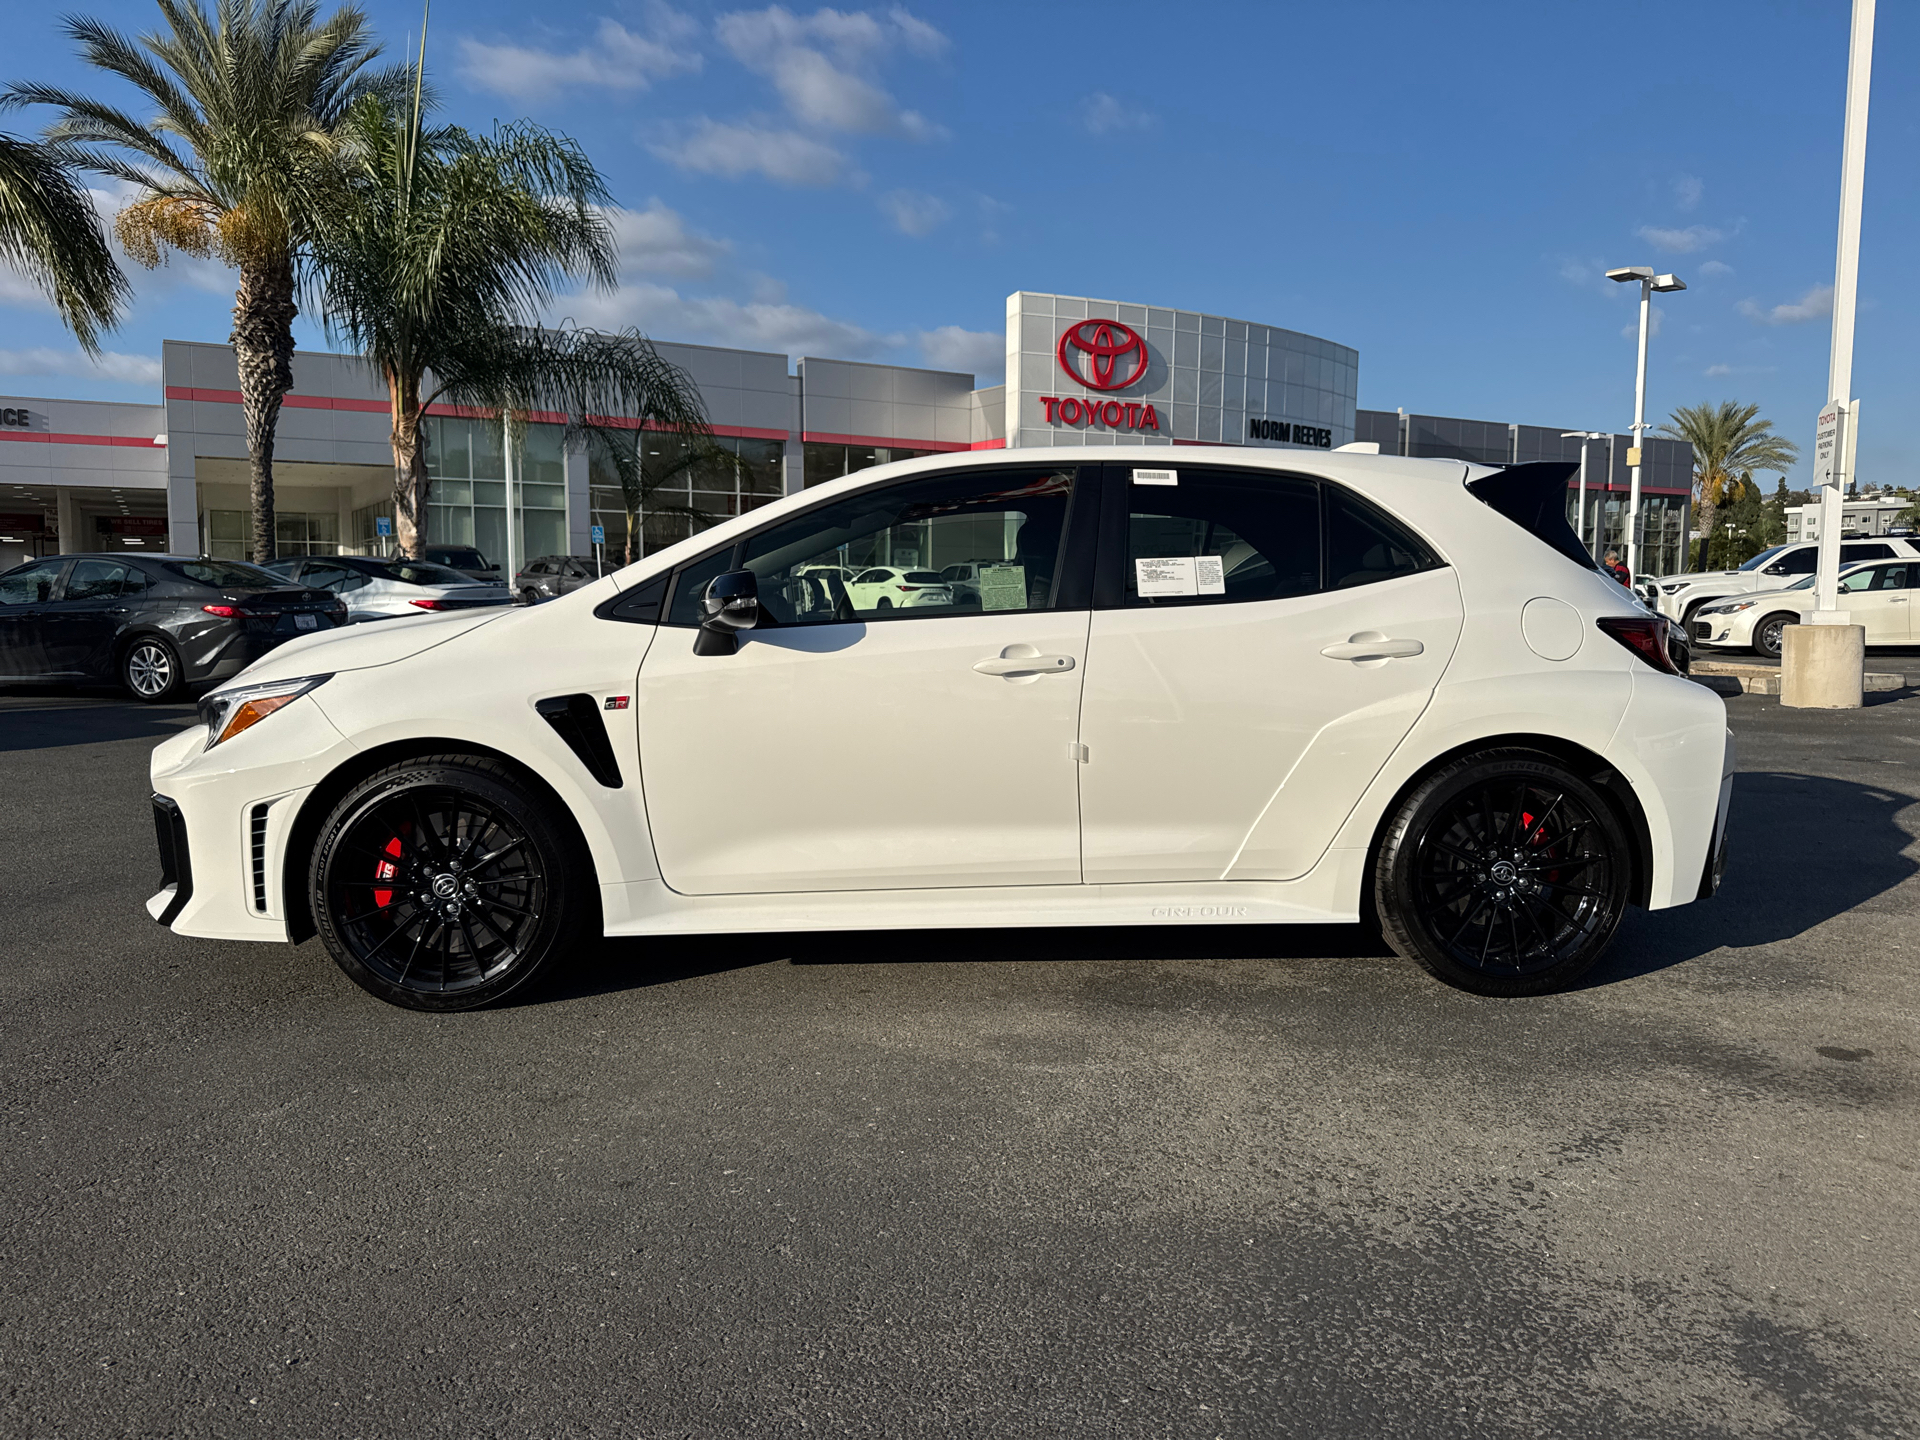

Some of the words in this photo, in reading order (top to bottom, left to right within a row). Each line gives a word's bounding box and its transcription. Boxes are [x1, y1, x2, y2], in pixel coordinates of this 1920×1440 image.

[1039, 396, 1159, 430] TOYOTA
[1818, 412, 1836, 426] TOYOTA
[1250, 418, 1291, 442] NORM
[1292, 424, 1332, 448] REEVES
[1817, 428, 1836, 441] CUSTOMER
[1818, 440, 1833, 450] PARKING
[1820, 451, 1830, 460] ONLY
[605, 700, 627, 709] GR
[323, 827, 337, 856] SPORT
[317, 856, 327, 882] PILOT
[316, 890, 343, 955] MICHELIN
